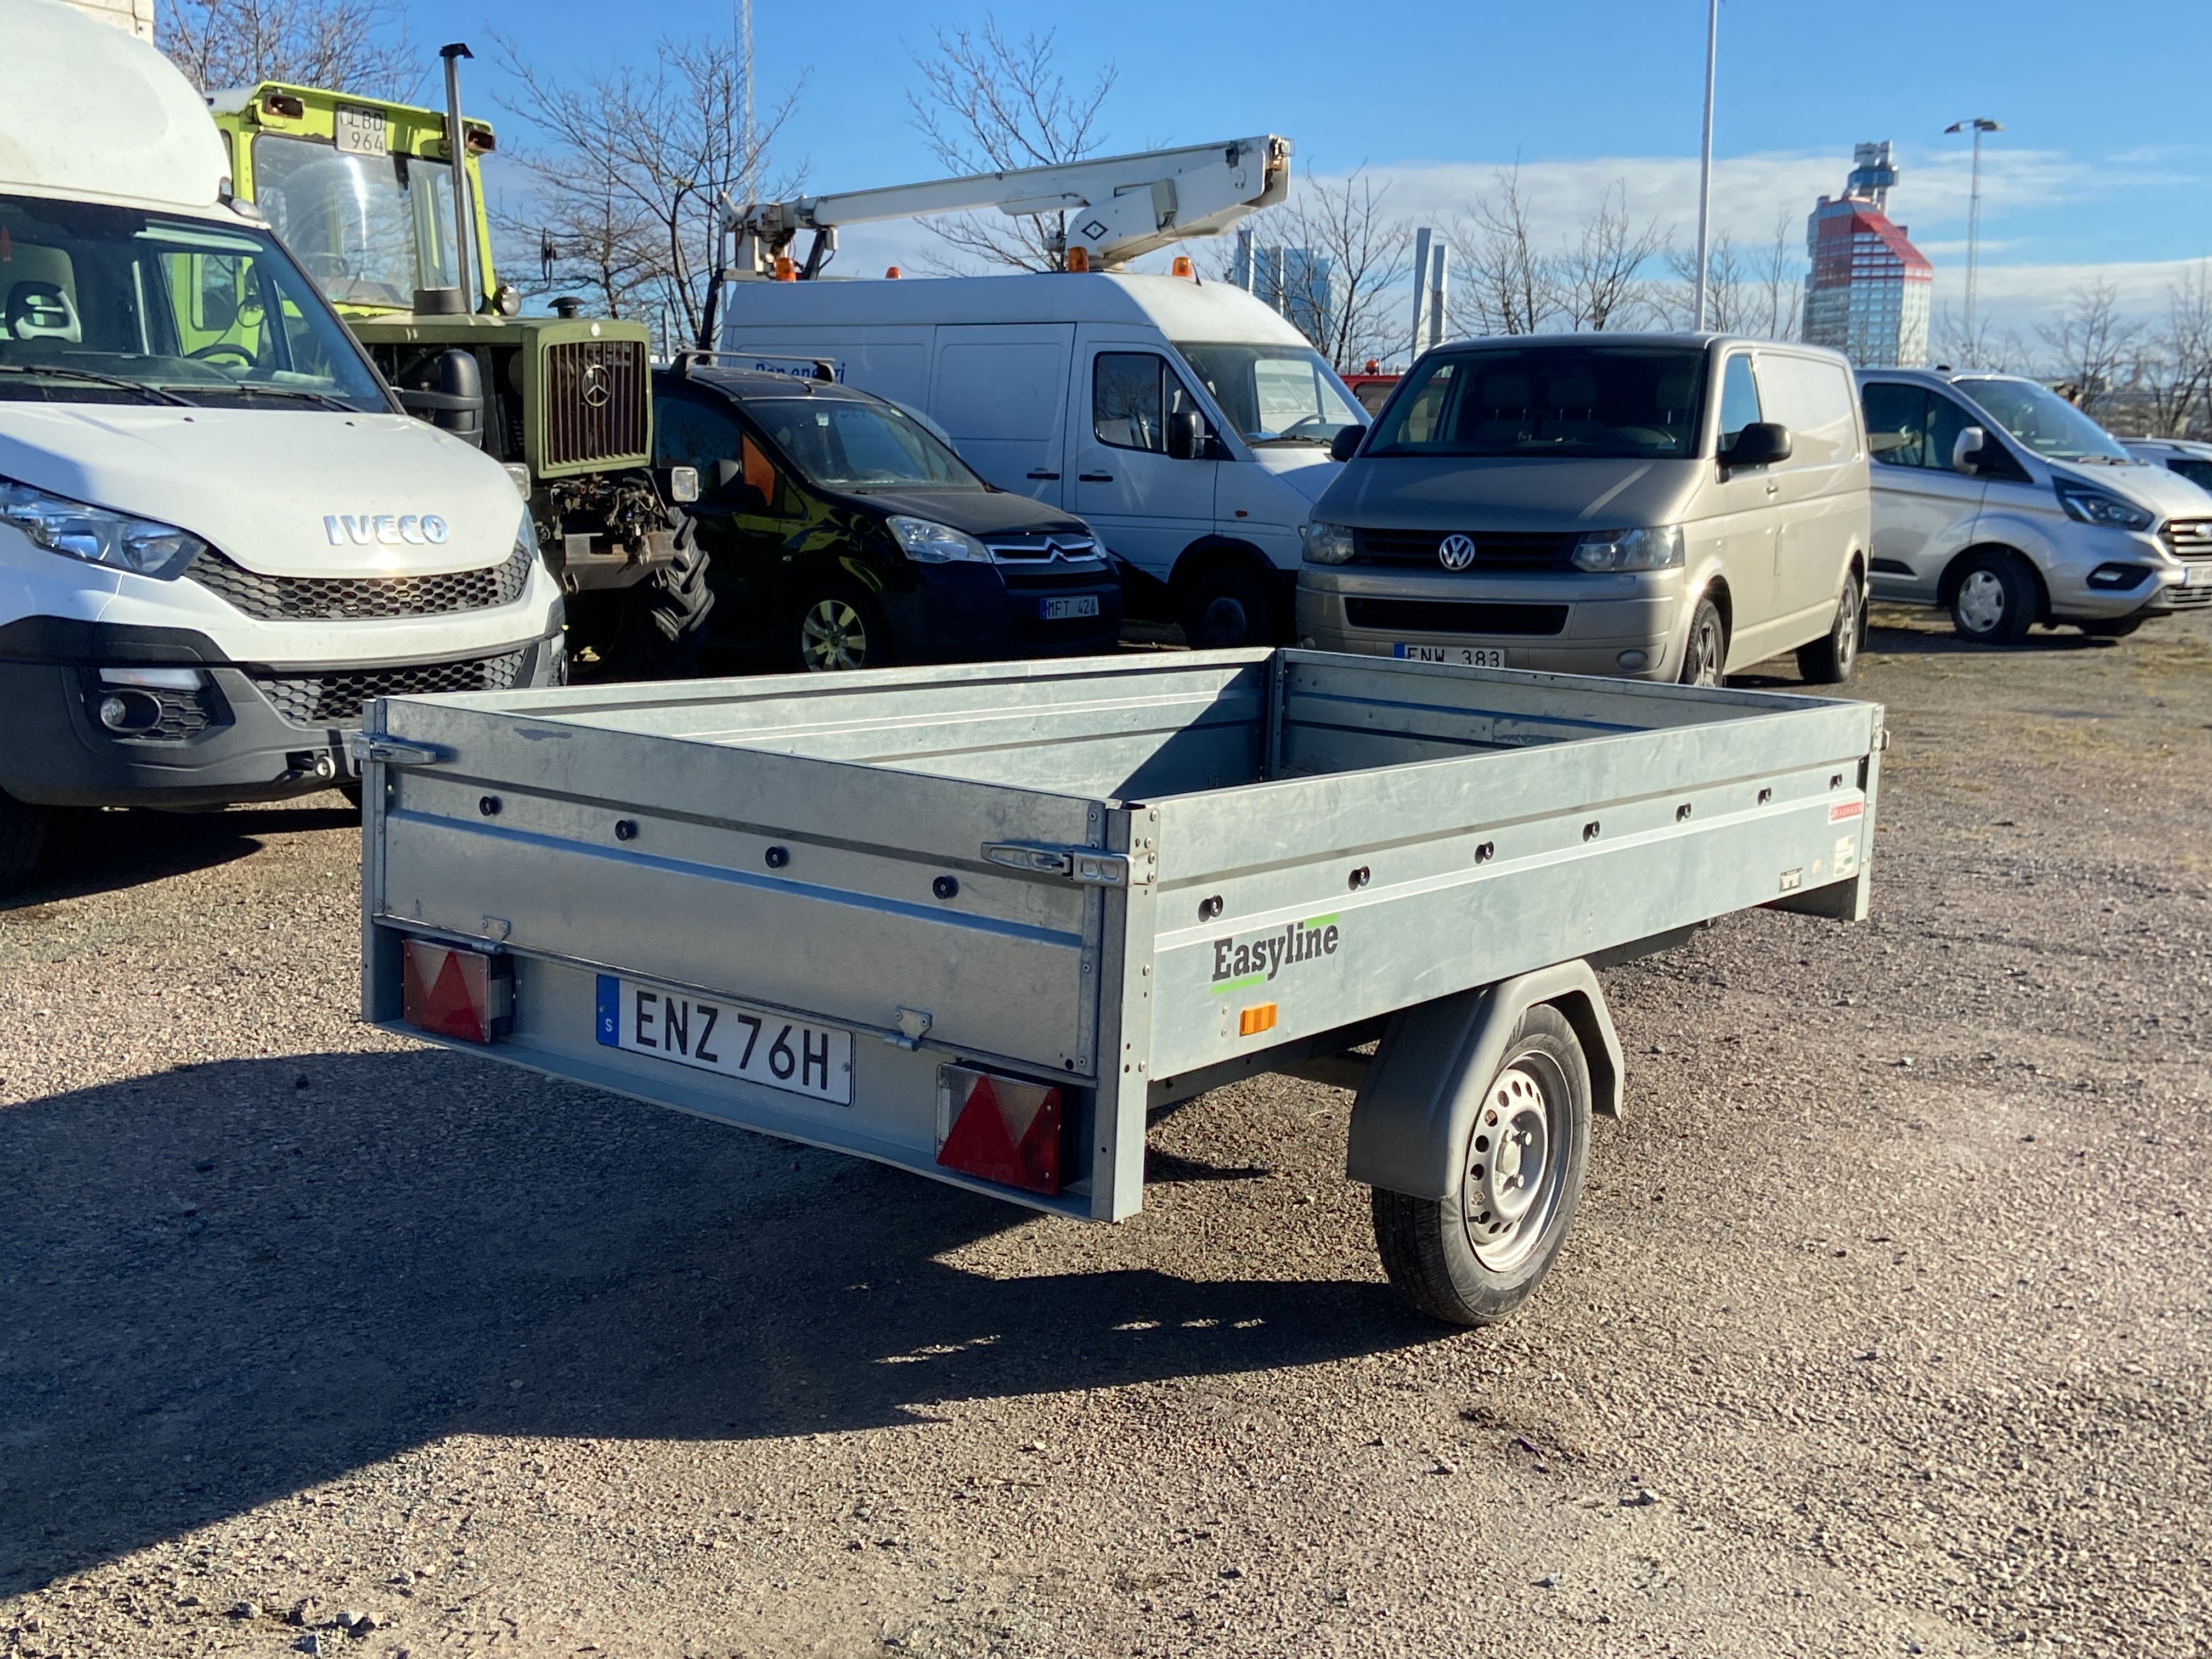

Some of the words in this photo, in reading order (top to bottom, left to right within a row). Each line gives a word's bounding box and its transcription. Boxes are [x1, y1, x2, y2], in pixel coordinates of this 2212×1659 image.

[351, 131, 383, 153] 964
[323, 515, 450, 545] IVECO
[1047, 600, 1070, 617] MFT
[1077, 598, 1096, 615] 424
[1462, 650, 1500, 668] 383
[1212, 922, 1339, 982] Easyline
[605, 1018, 613, 1032] S
[636, 990, 718, 1063] ENZ
[738, 1013, 828, 1091] 76H
